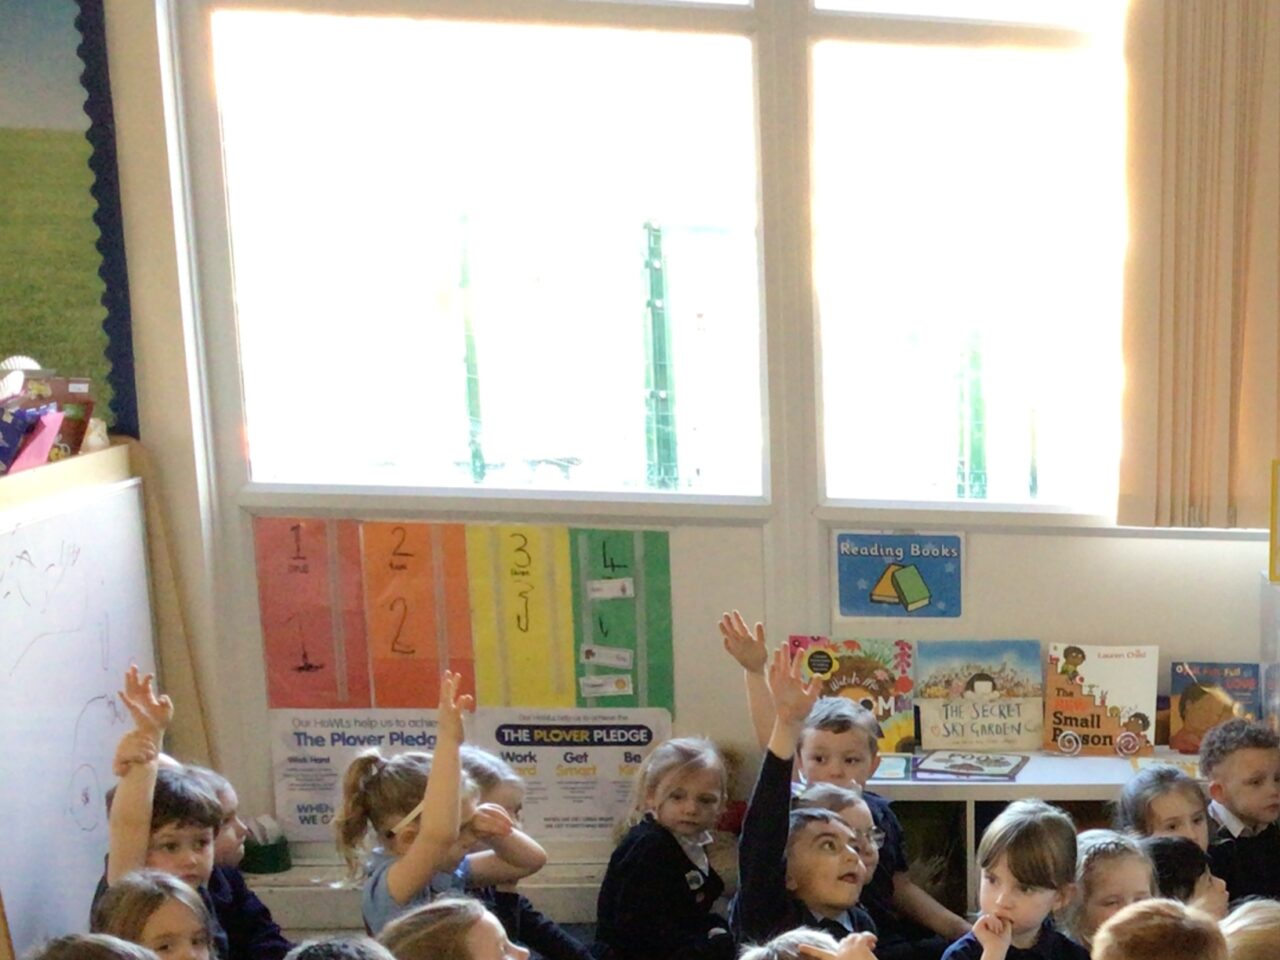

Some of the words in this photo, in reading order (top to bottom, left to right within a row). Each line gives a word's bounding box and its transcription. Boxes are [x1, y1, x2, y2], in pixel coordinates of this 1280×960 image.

[290, 523, 306, 560] 1
[391, 526, 415, 557] 2
[510, 532, 532, 568] 3
[602, 540, 628, 572] 4
[840, 542, 904, 560] Reading
[910, 543, 959, 557] Books
[389, 597, 416, 655] 2
[1097, 651, 1125, 659] Lauren
[1126, 650, 1147, 659] Child
[1055, 687, 1074, 698] The
[941, 703, 965, 719] THE
[972, 702, 1022, 719] SECRET
[353, 717, 378, 730] help
[380, 719, 392, 728] us
[394, 718, 406, 728] to
[408, 717, 438, 728] achie
[942, 722, 967, 737] SKY
[970, 721, 1022, 737] GARDEN
[1053, 711, 1101, 729] Small
[293, 731, 325, 747] The
[331, 731, 385, 747] Plover
[389, 731, 438, 749] Pledg
[502, 729, 531, 742] THE
[533, 729, 590, 742] PLOVER
[593, 729, 648, 742] PLEDGE
[1052, 727, 1114, 747] Pson
[563, 752, 589, 764] Get
[624, 752, 642, 764] Be
